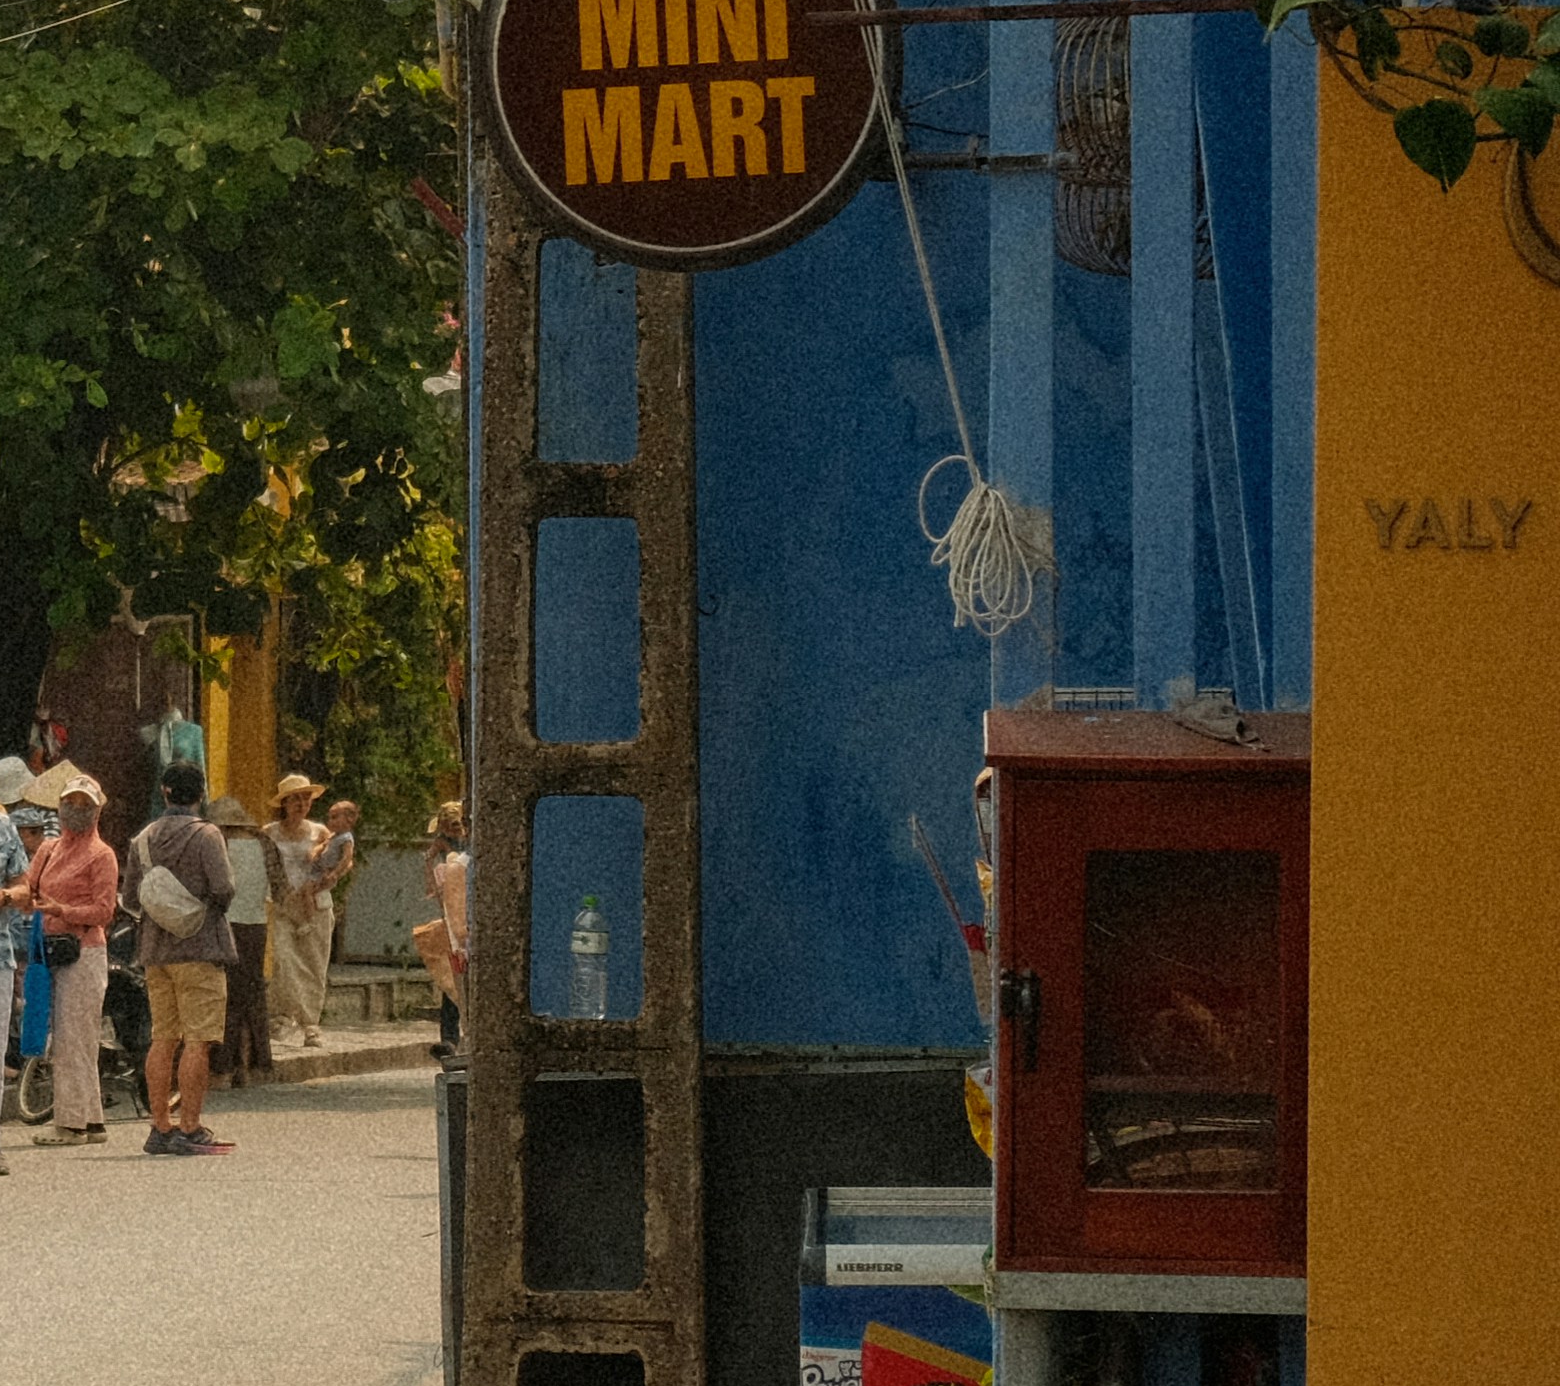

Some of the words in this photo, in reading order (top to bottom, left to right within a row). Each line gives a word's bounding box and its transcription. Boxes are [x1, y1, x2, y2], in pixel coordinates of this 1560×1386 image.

[561, 76, 816, 187] MART
[1363, 497, 1533, 551] YALY
[836, 1262, 904, 1273] LIEBHERR
